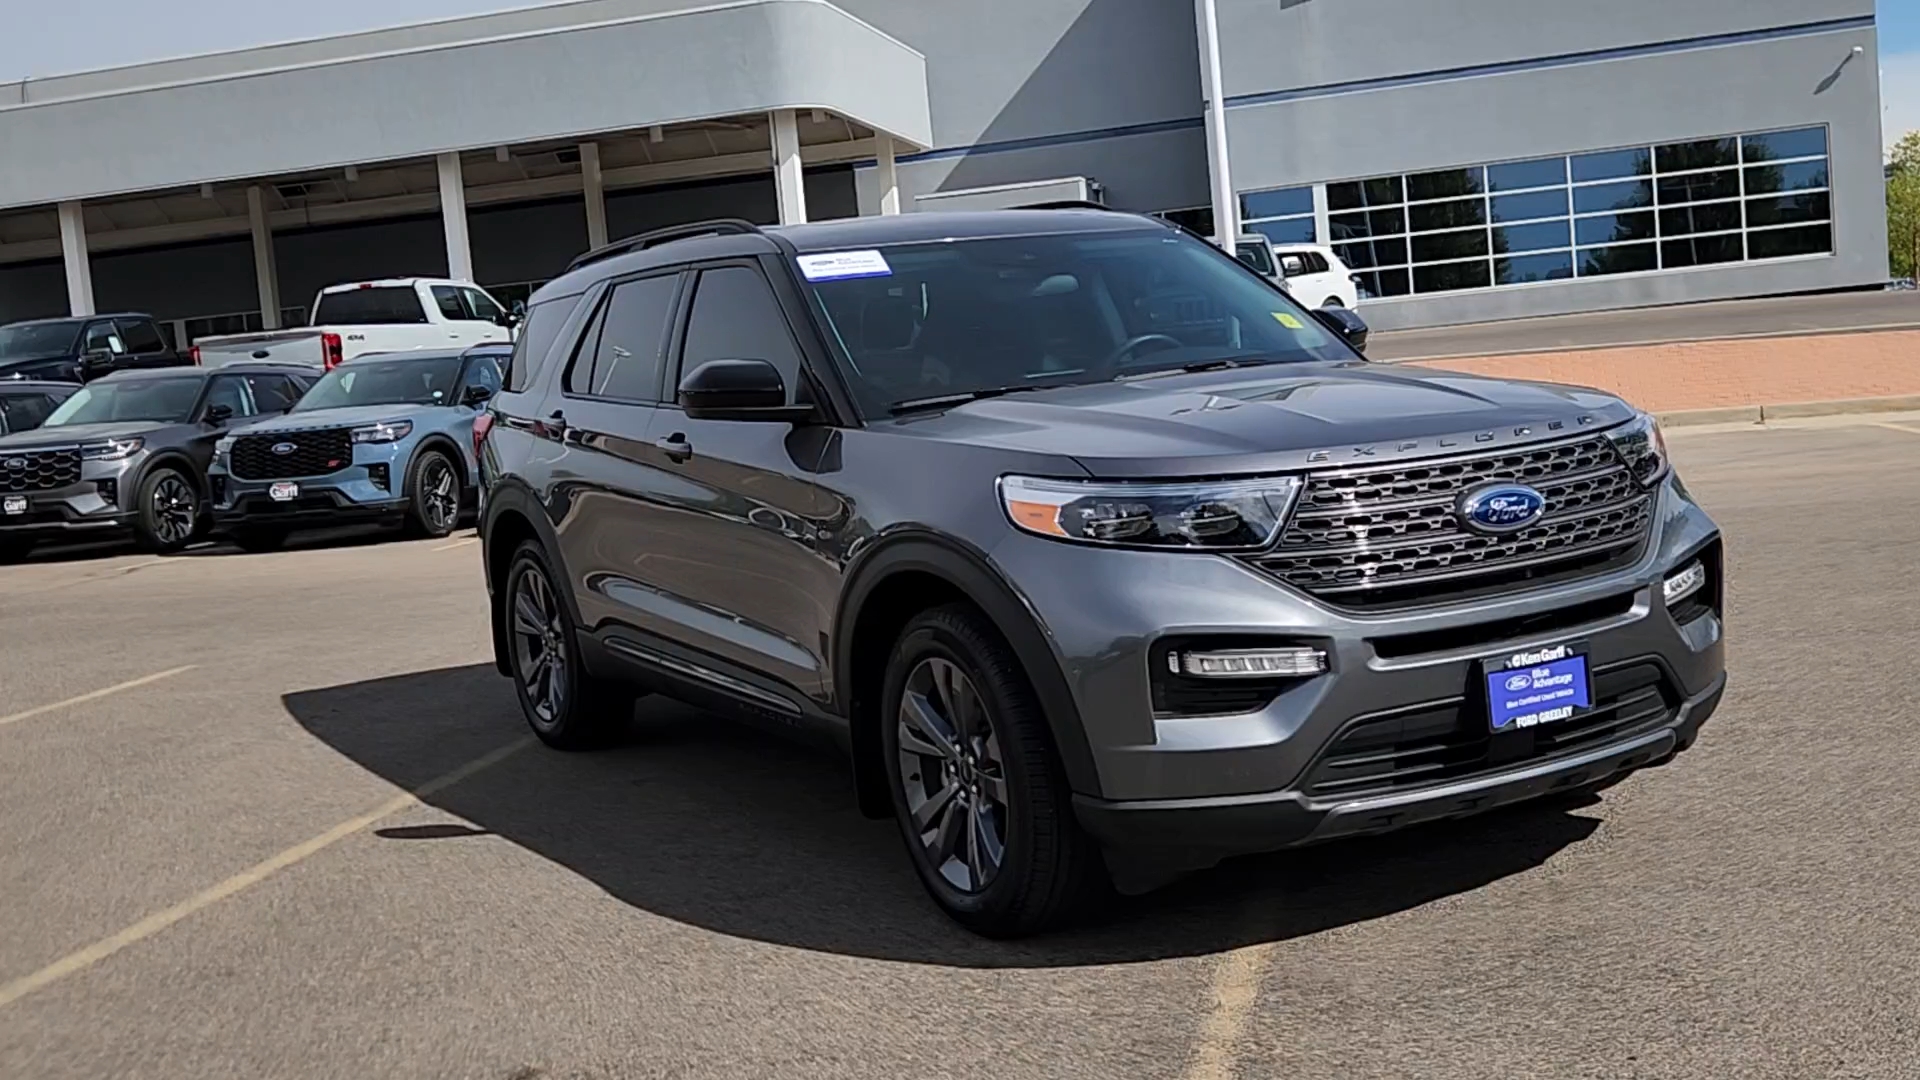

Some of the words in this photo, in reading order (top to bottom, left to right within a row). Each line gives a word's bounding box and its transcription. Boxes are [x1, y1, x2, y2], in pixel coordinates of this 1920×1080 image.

[1306, 415, 1593, 463] EXPLORER
[1520, 652, 1541, 667] Ken
[1540, 645, 1565, 662] Garff
[1532, 668, 1551, 679] Blue
[1533, 673, 1573, 689] Advantage
[1516, 713, 1538, 728] FORD
[1539, 705, 1573, 723] GREELEY
